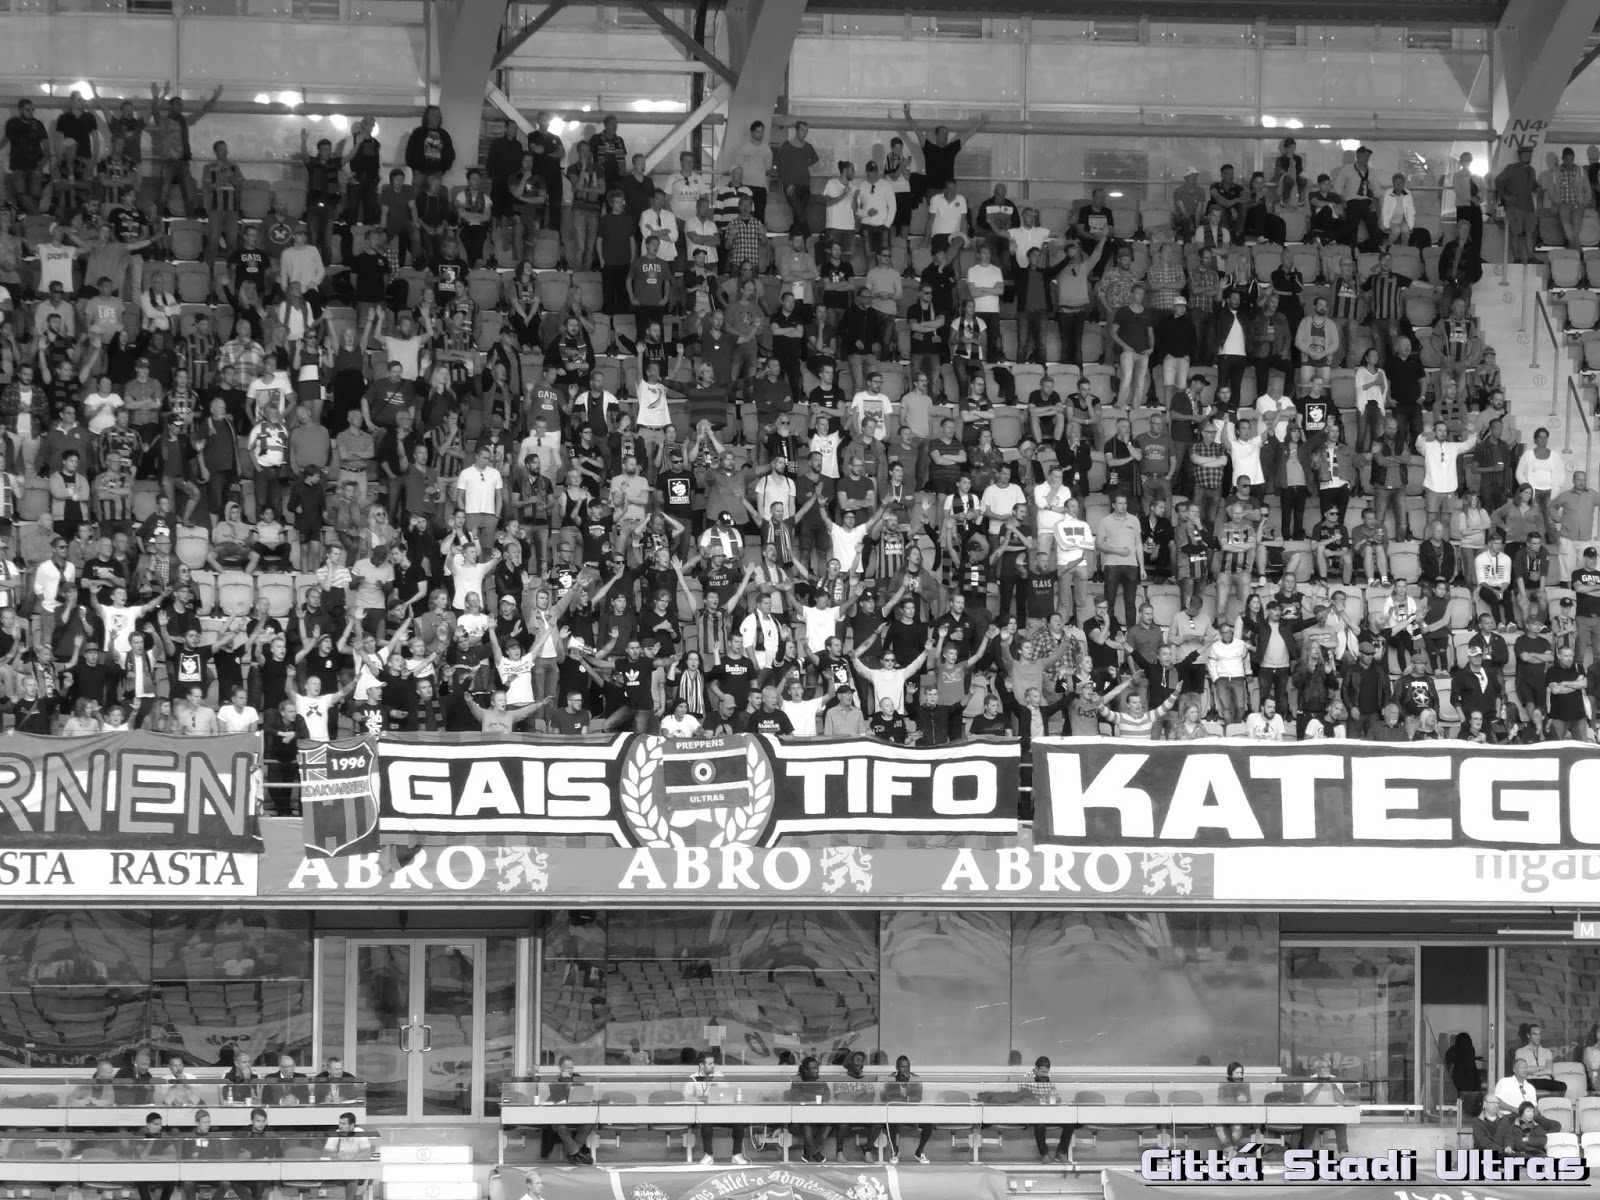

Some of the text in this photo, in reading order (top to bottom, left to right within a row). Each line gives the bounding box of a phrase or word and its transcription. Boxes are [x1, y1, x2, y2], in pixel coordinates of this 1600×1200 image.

[1512, 119, 1542, 132] N4
[1508, 133, 1539, 148] N5
[241, 253, 262, 262] GAIS
[643, 263, 662, 273] GAIS
[537, 390, 558, 401] GAIS
[676, 738, 725, 750] PREPPENS
[331, 755, 366, 771] 1996
[388, 758, 998, 817] GAIS TIFO
[689, 793, 725, 804] ULTRAS
[109, 851, 244, 885] RASTA
[288, 846, 1132, 892] ABRO ABRO ABRO
